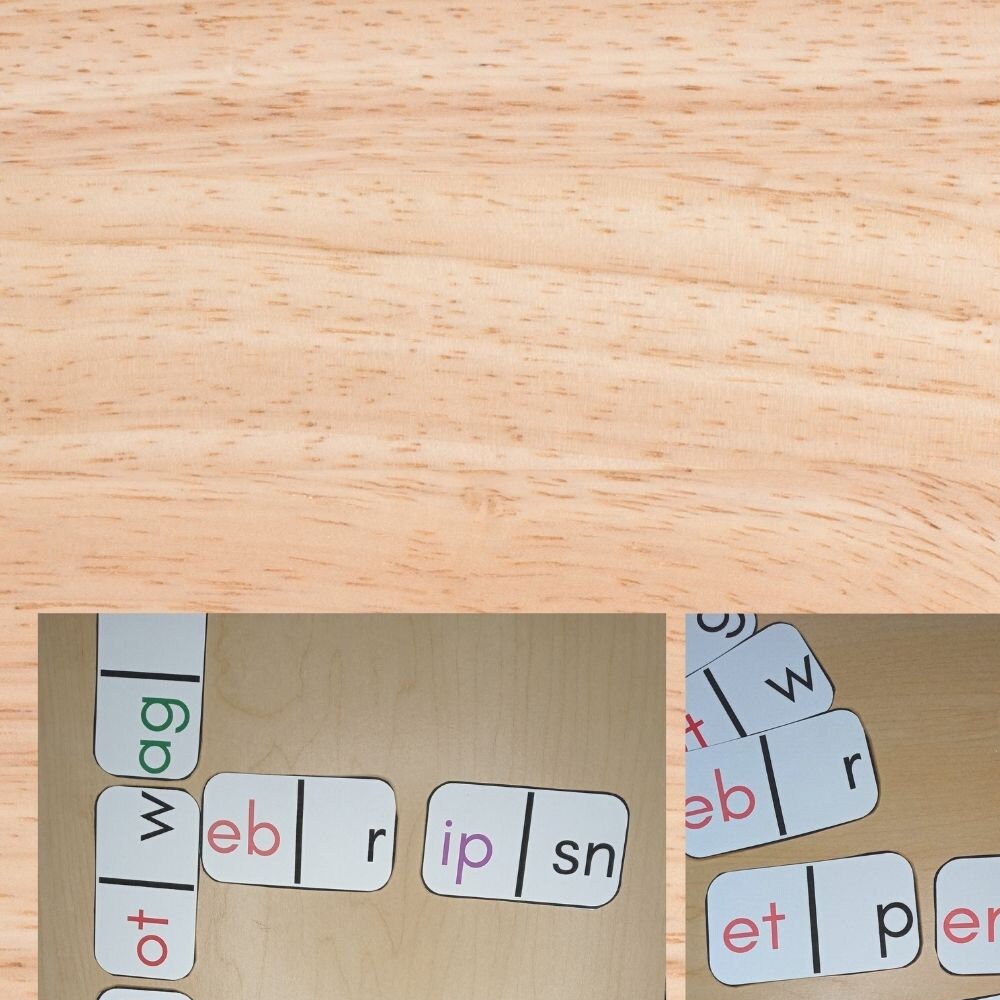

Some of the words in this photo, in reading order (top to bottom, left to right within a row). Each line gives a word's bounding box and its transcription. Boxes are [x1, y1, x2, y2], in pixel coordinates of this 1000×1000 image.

[764, 654, 814, 703] w
[138, 696, 190, 774] ag
[140, 790, 176, 842] w
[685, 769, 756, 830] eb
[843, 752, 862, 790] r
[207, 799, 281, 857] eb
[367, 828, 387, 863] r
[441, 820, 493, 885] ip
[552, 839, 616, 878] sn
[127, 909, 169, 968] ot
[723, 902, 785, 954] et
[876, 901, 914, 959] p
